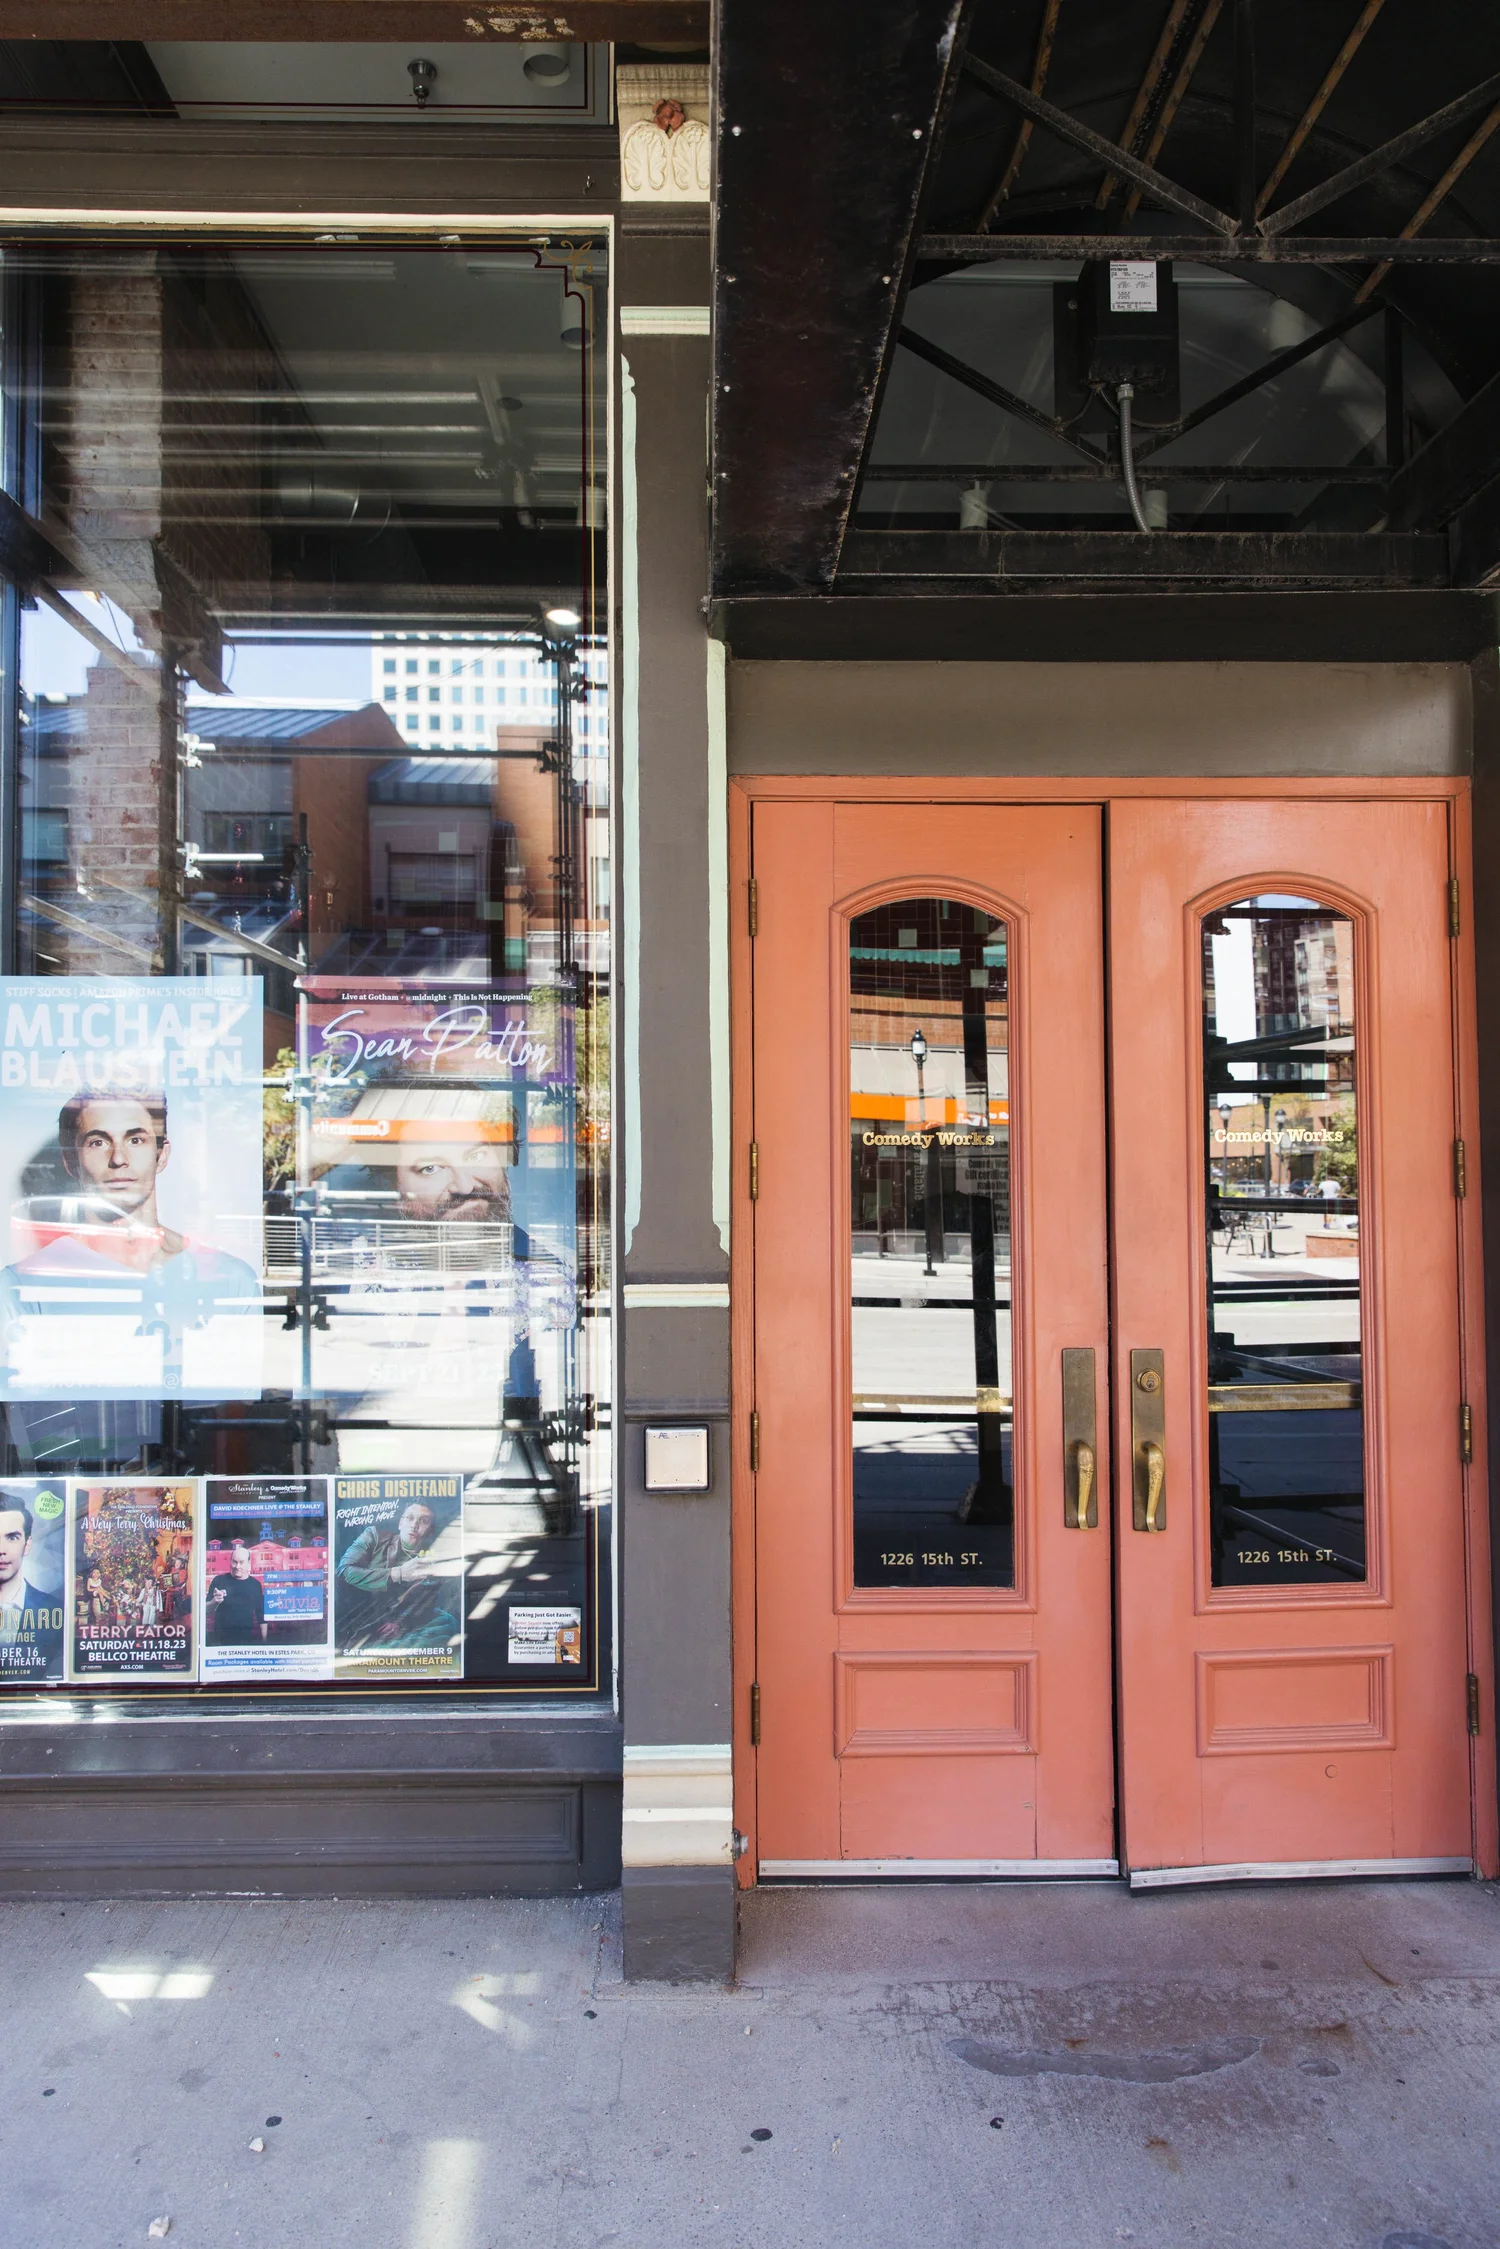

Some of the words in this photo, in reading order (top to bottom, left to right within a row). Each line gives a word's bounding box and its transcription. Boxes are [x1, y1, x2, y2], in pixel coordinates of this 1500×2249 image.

[5, 987, 36, 997] STIFF
[37, 987, 71, 997] SOCKS
[342, 993, 358, 1001] Live
[368, 993, 399, 1001] Gotham
[453, 993, 470, 1001] This
[471, 993, 478, 1001] Is
[478, 993, 491, 1001] Not
[492, 993, 533, 1003] Happening
[4, 1003, 243, 1047] MICHAEL
[321, 1009, 419, 1080] Sean
[421, 1005, 552, 1074] Patton
[1, 1050, 243, 1088] BLAUSTEIN
[862, 1131, 934, 1149] Comedy
[936, 1131, 995, 1146] Works
[1214, 1129, 1285, 1144] Comedy
[1286, 1128, 1344, 1142] Works
[228, 1482, 262, 1495] Stanley
[337, 1480, 380, 1499] CHRIS
[384, 1480, 456, 1497] DISTEFANO
[336, 1508, 360, 1520] RIGHT
[344, 1514, 374, 1527] WRONG
[376, 1510, 396, 1522] MOVE
[80, 1518, 88, 1530] A
[90, 1517, 112, 1532] Very
[115, 1516, 138, 1532] Terry
[880, 1553, 914, 1565] 1226
[921, 1552, 954, 1565] 15th
[960, 1553, 982, 1565] ST.
[1237, 1551, 1270, 1564] 1226
[1277, 1549, 1309, 1562] 15th
[1315, 1549, 1337, 1561] ST.
[277, 1592, 320, 1609] trivia
[79, 1625, 132, 1638] TERRY
[136, 1624, 186, 1638] FATOR
[80, 1640, 136, 1650] SATURDAY
[142, 1640, 186, 1650] 11.18.23
[27, 1647, 39, 1658] 16
[88, 1652, 128, 1662] BELLCO
[129, 1651, 176, 1660] THEATRE
[8, 1657, 46, 1666] THEATRE
[345, 1658, 406, 1666] RAMOUNT
[408, 1657, 453, 1665] THEATRE
